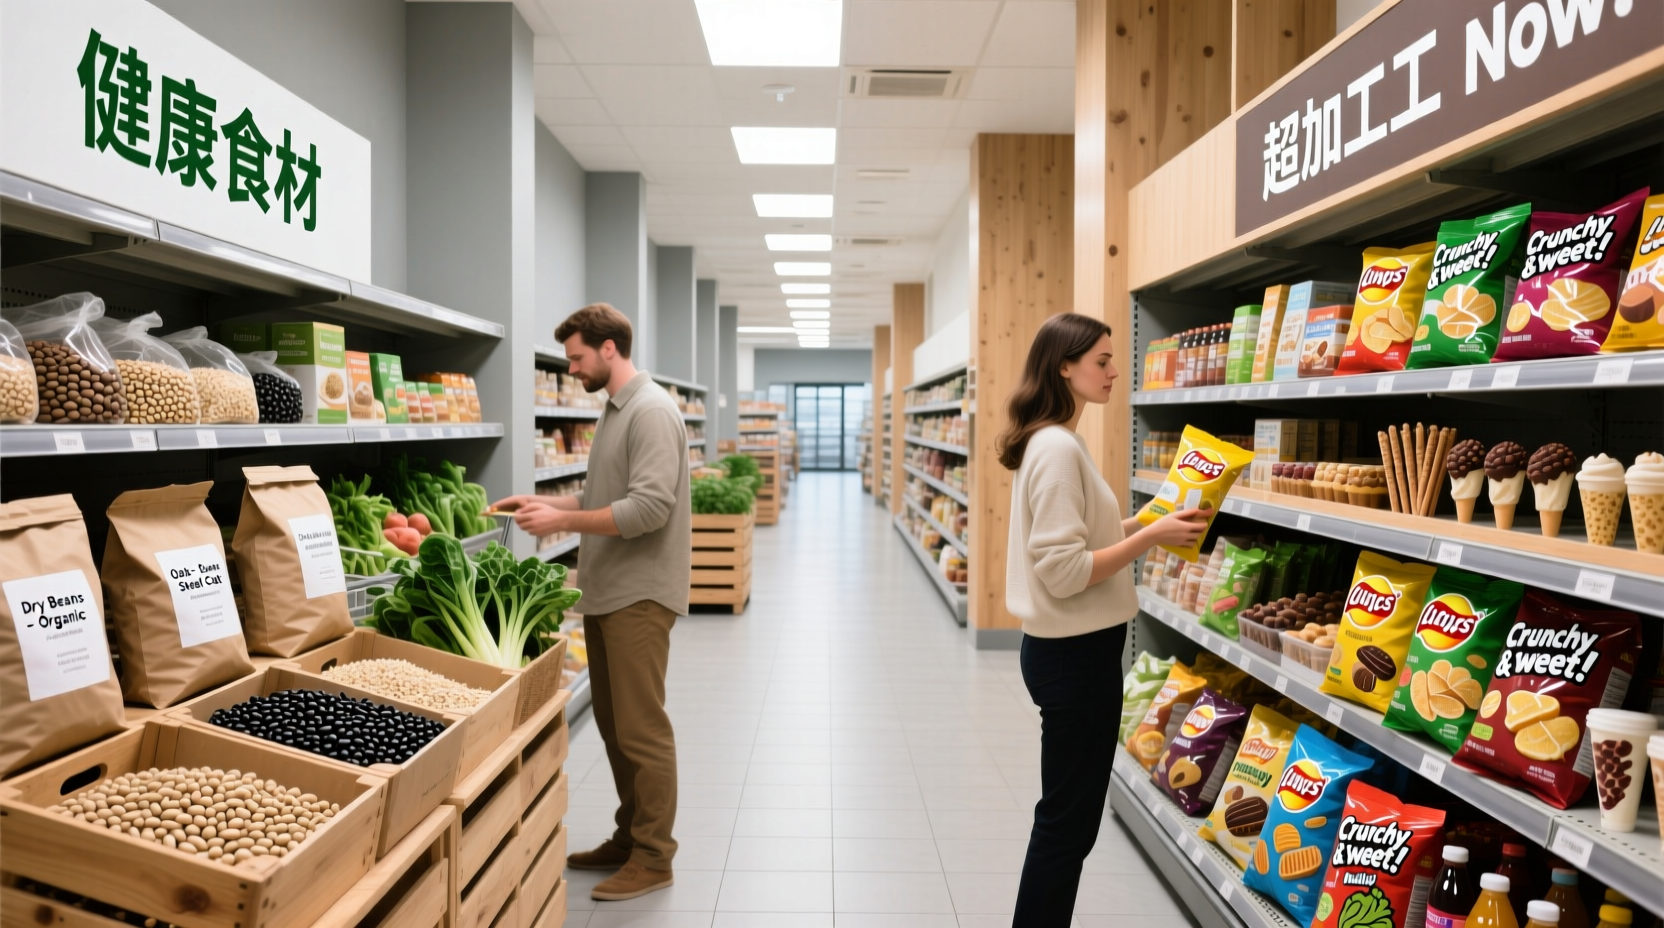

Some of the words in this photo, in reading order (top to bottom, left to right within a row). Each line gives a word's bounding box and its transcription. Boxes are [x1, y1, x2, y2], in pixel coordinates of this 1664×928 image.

[1263, 29, 1441, 201] 超加工工
[1466, 0, 1634, 96] Now
[77, 28, 322, 232] 健康食材
[1527, 215, 1614, 256] Crunchy
[21, 601, 45, 615] Dry
[47, 594, 85, 609] Beans
[38, 609, 87, 629] Organic
[1506, 622, 1599, 656] Crunchy
